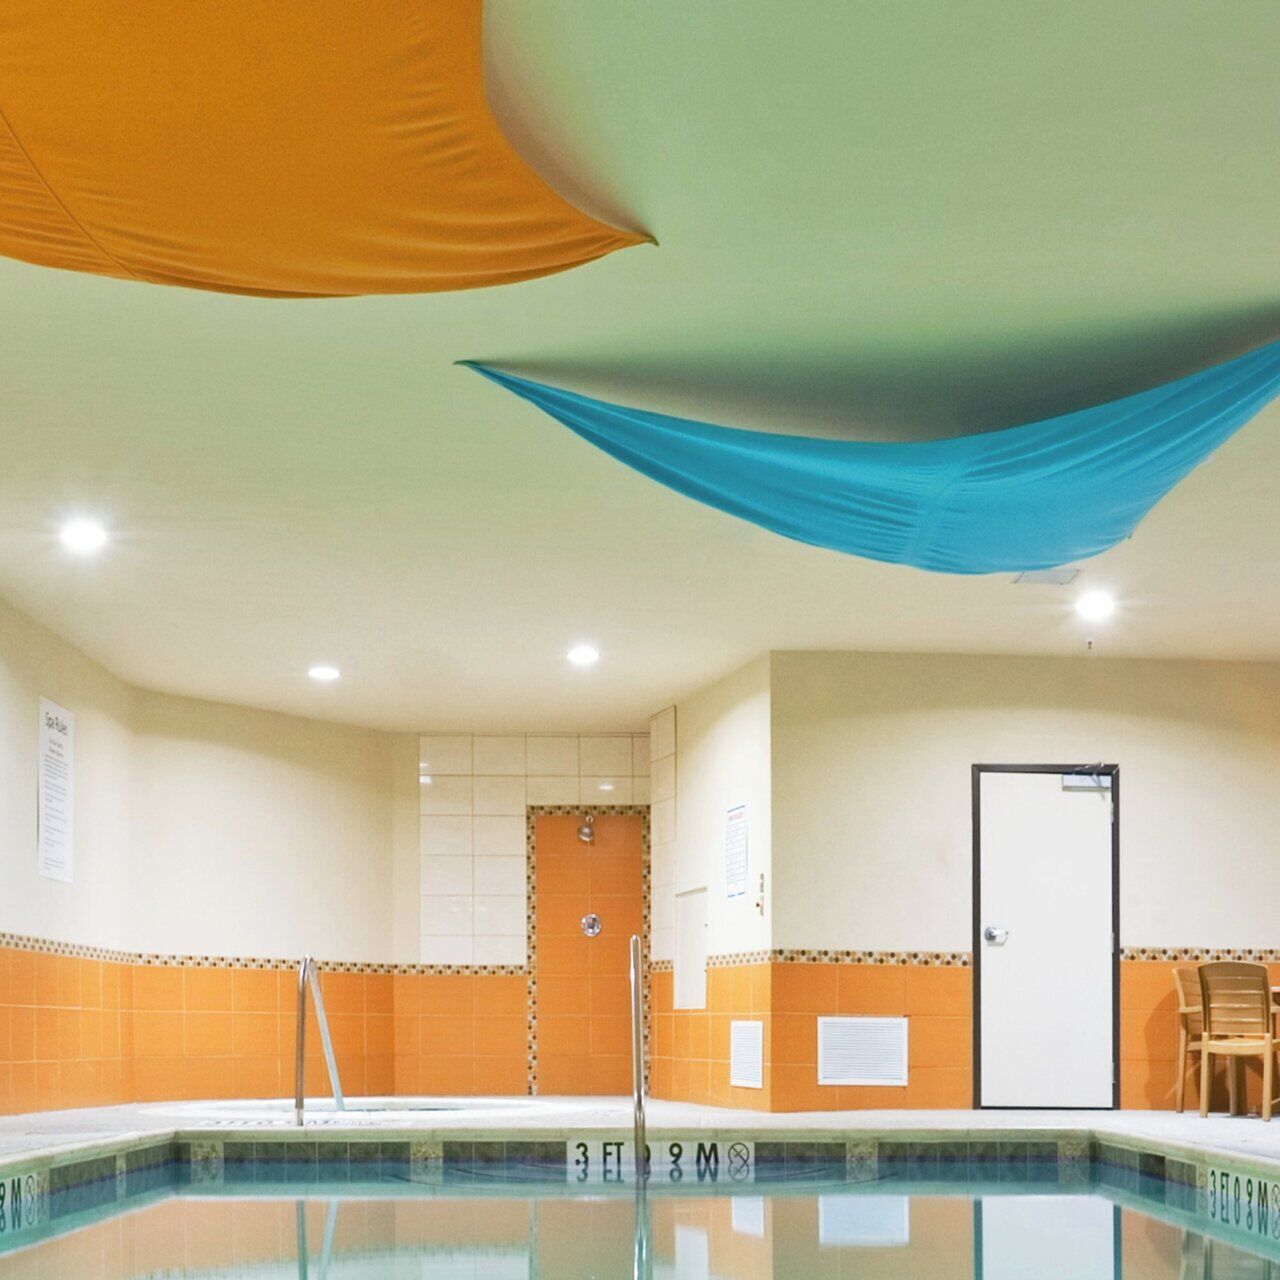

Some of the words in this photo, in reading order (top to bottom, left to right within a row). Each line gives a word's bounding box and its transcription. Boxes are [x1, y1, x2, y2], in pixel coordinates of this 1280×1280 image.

[575, 1142, 589, 1166] 3
[602, 1142, 624, 1165] FT
[669, 1142, 683, 1164] 9
[696, 1142, 719, 1165] M
[11, 1178, 21, 1205] M
[1210, 1169, 1217, 1197] 3
[1221, 1172, 1229, 1197] FT
[1258, 1180, 1268, 1209] M
